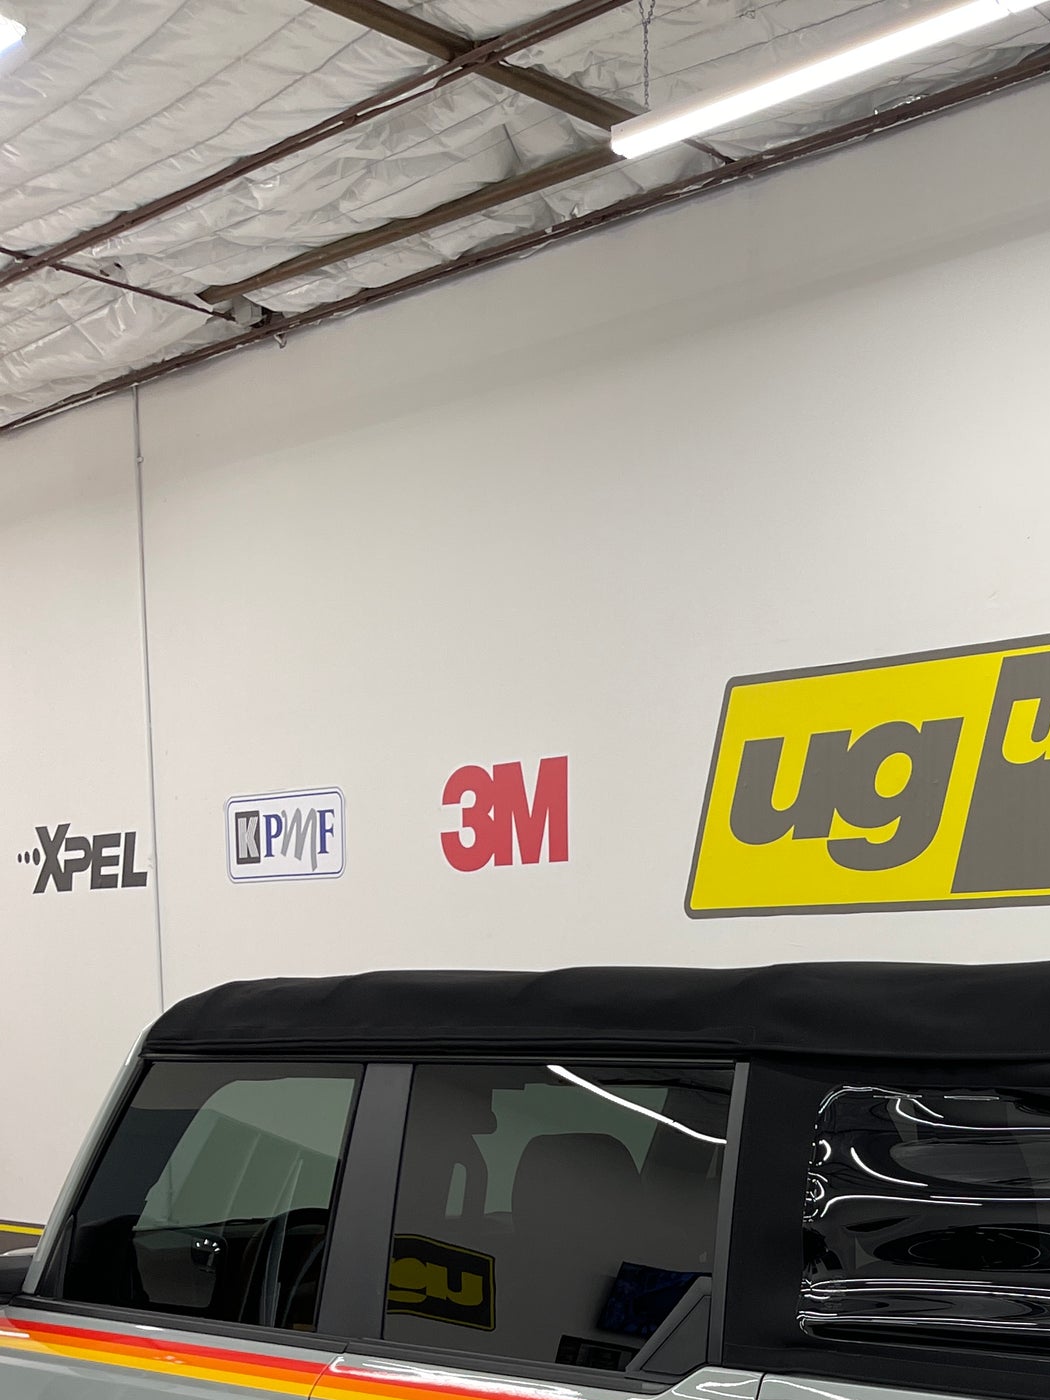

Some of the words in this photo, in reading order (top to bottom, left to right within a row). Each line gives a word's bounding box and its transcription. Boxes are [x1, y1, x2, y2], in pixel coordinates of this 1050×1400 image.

[234, 808, 336, 872] KPMF
[440, 756, 569, 872] 3M
[730, 718, 963, 871] ug
[32, 823, 148, 895] XPEL
